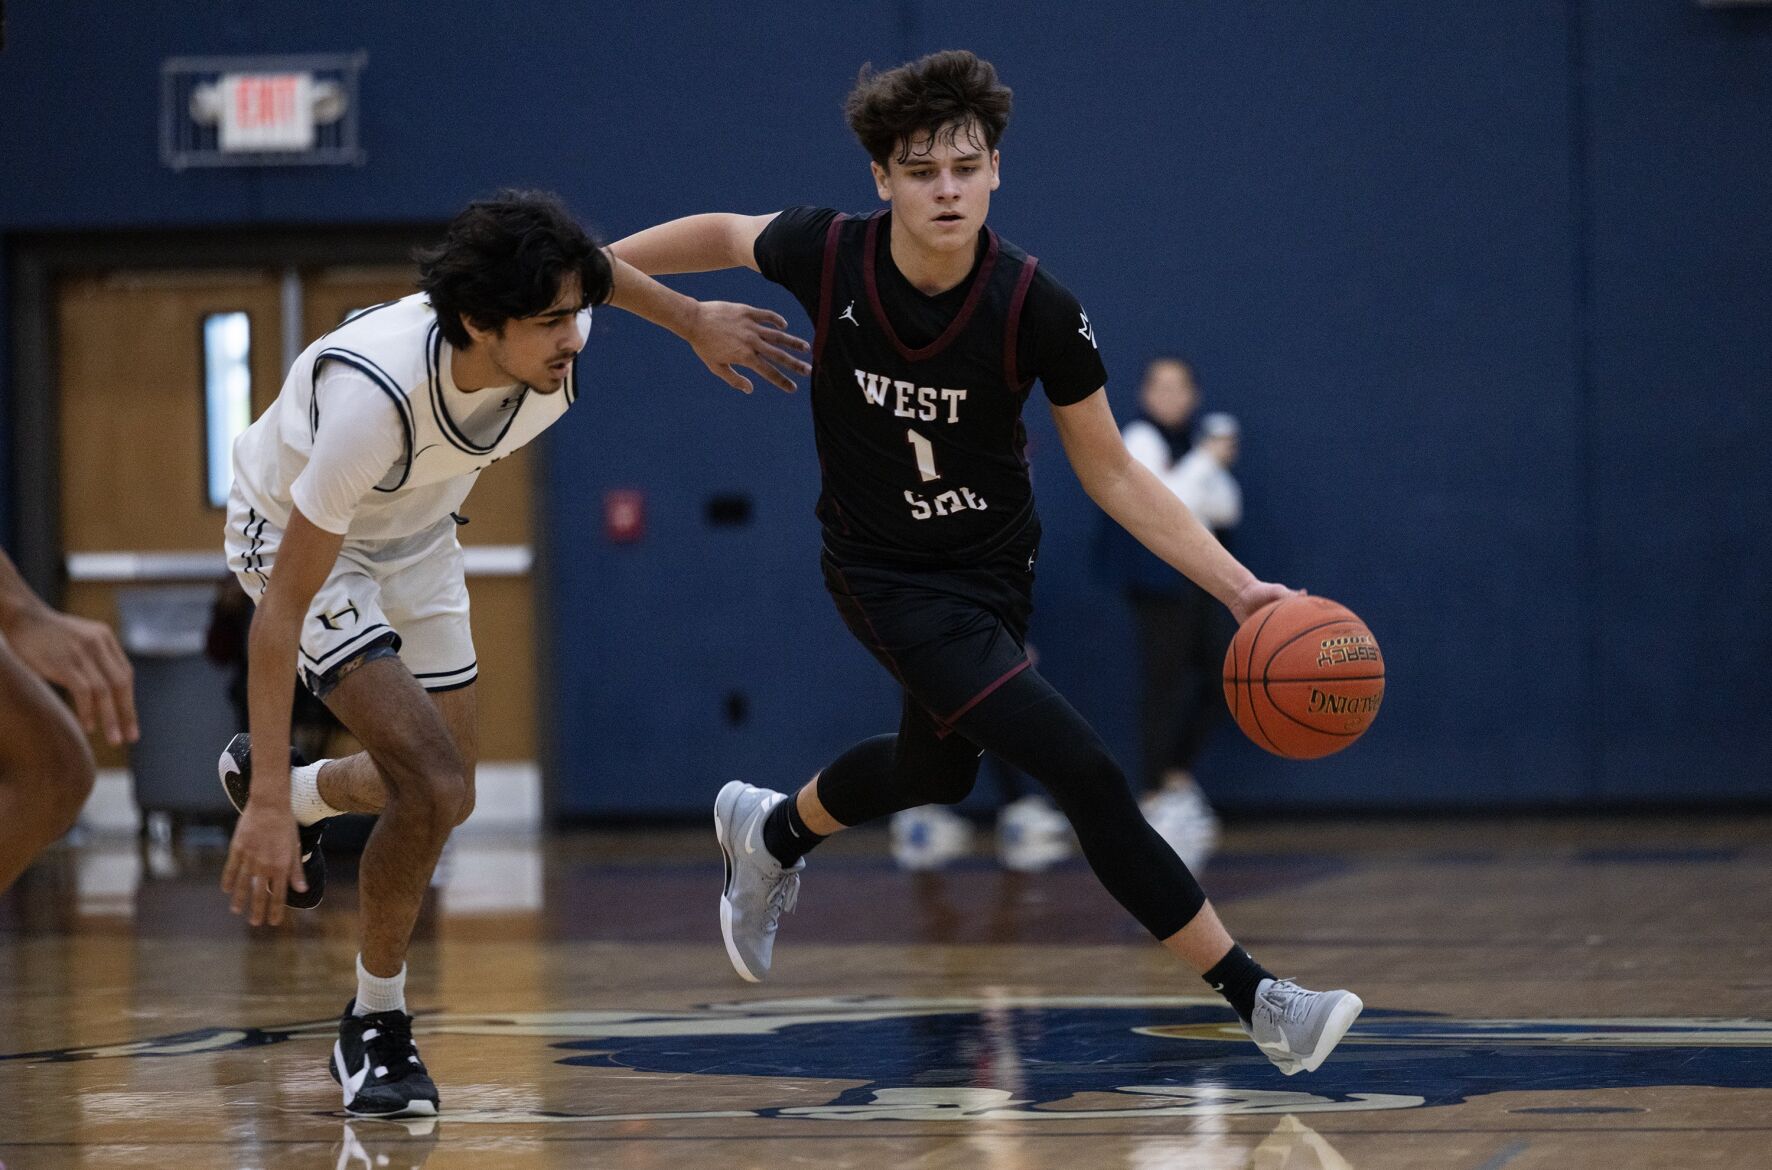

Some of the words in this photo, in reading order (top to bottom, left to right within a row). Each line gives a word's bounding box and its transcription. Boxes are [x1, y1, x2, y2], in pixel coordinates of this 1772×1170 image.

[854, 368, 968, 424] WEST
[906, 427, 942, 483] 1
[1316, 645, 1380, 668] EGACY
[1307, 687, 1381, 715] ALDING
